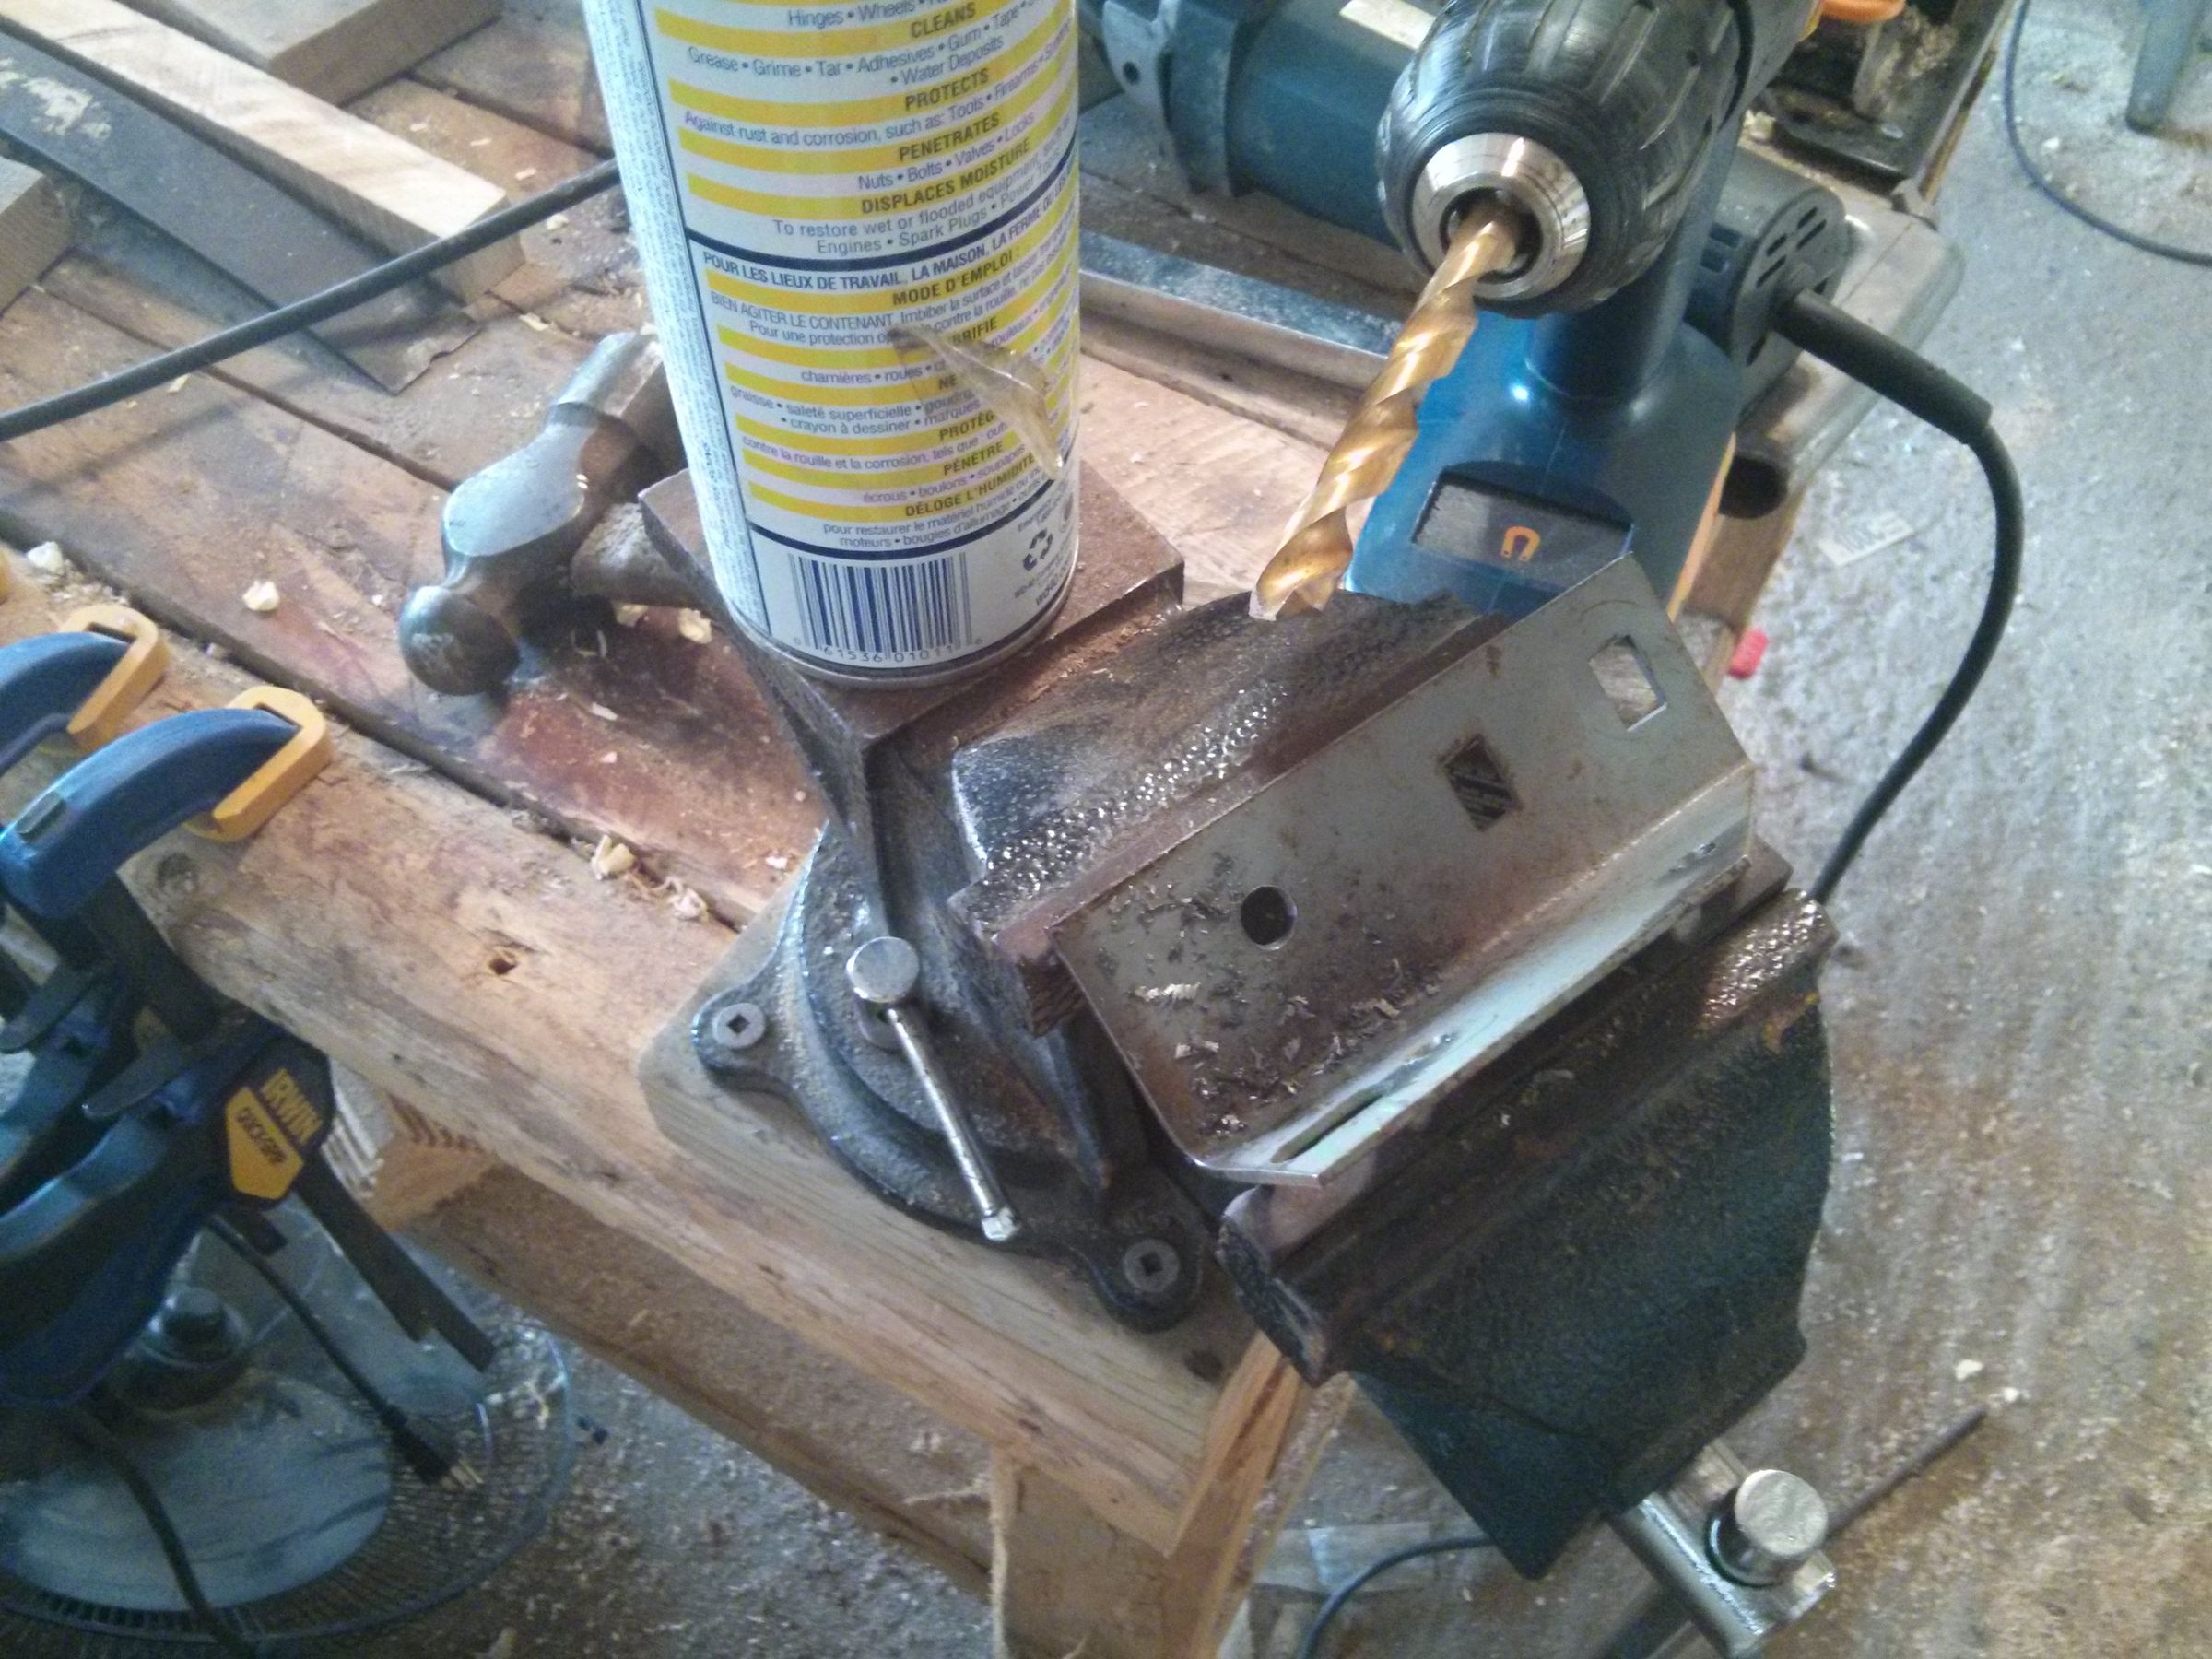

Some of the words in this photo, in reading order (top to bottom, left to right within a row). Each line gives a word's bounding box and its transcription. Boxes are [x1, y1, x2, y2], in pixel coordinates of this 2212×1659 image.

[788, 9, 844, 29] Hinges
[858, 1, 915, 22] Wheels
[911, 3, 976, 38] CLEANS
[688, 46, 739, 72] Grease
[753, 58, 801, 77] Grime
[815, 60, 841, 76] Tar
[858, 45, 935, 74] Adhesives
[947, 28, 982, 51] Gum
[900, 61, 944, 85] Water
[949, 35, 1005, 72] Deposits
[905, 67, 990, 111] PROTECTS
[685, 110, 735, 136] Against
[738, 126, 768, 142] rust
[771, 130, 799, 146] and
[886, 119, 922, 139] such
[948, 95, 984, 121] Tools
[899, 112, 1000, 162] PENETRATES
[858, 172, 894, 191] Nuts
[907, 160, 943, 183] Bolts
[955, 142, 995, 167] Valves
[861, 179, 955, 215] DISPLACES
[959, 136, 1030, 188] MOISTURE
[772, 219, 794, 235] To
[800, 222, 858, 238] restore
[864, 218, 891, 235] wet
[897, 217, 914, 229] or
[918, 193, 973, 225] flooded
[816, 239, 882, 255] Engines
[899, 226, 944, 248] Spark
[949, 203, 988, 231] Plugs
[703, 251, 739, 276] POUR
[742, 265, 768, 284] LES
[771, 271, 813, 289] LIEUX
[818, 276, 837, 290] DE
[912, 264, 931, 281] LA
[934, 242, 991, 275] MAISON,
[992, 230, 1006, 250] LA
[711, 290, 738, 312] BIEN
[740, 304, 787, 324] AGITER
[790, 313, 806, 328] LE
[809, 313, 894, 331] CONTENANT
[900, 302, 947, 324] Imbiber
[950, 295, 960, 309] la
[892, 282, 941, 306] MODE
[750, 320, 778, 338] Pour
[782, 330, 806, 343] une
[809, 329, 875, 347] protection
[935, 309, 971, 330] contre
[973, 302, 983, 316] la
[951, 316, 998, 346] BRIFIE
[790, 418, 837, 434] crayon
[841, 418, 849, 434] à
[852, 418, 911, 435] dessiner
[829, 403, 912, 423] superficielle
[742, 435, 780, 455] contre
[781, 450, 792, 461] la
[794, 452, 832, 468] rouille
[835, 457, 848, 469] et
[850, 457, 862, 470] la
[918, 477, 967, 496] boulons
[823, 523, 853, 535] pour
[855, 523, 912, 536] restaurer
[913, 519, 924, 532] le
[840, 535, 893, 547] moteurs
[903, 526, 952, 547] bougies
[260, 1068, 323, 1146] IRWIN
